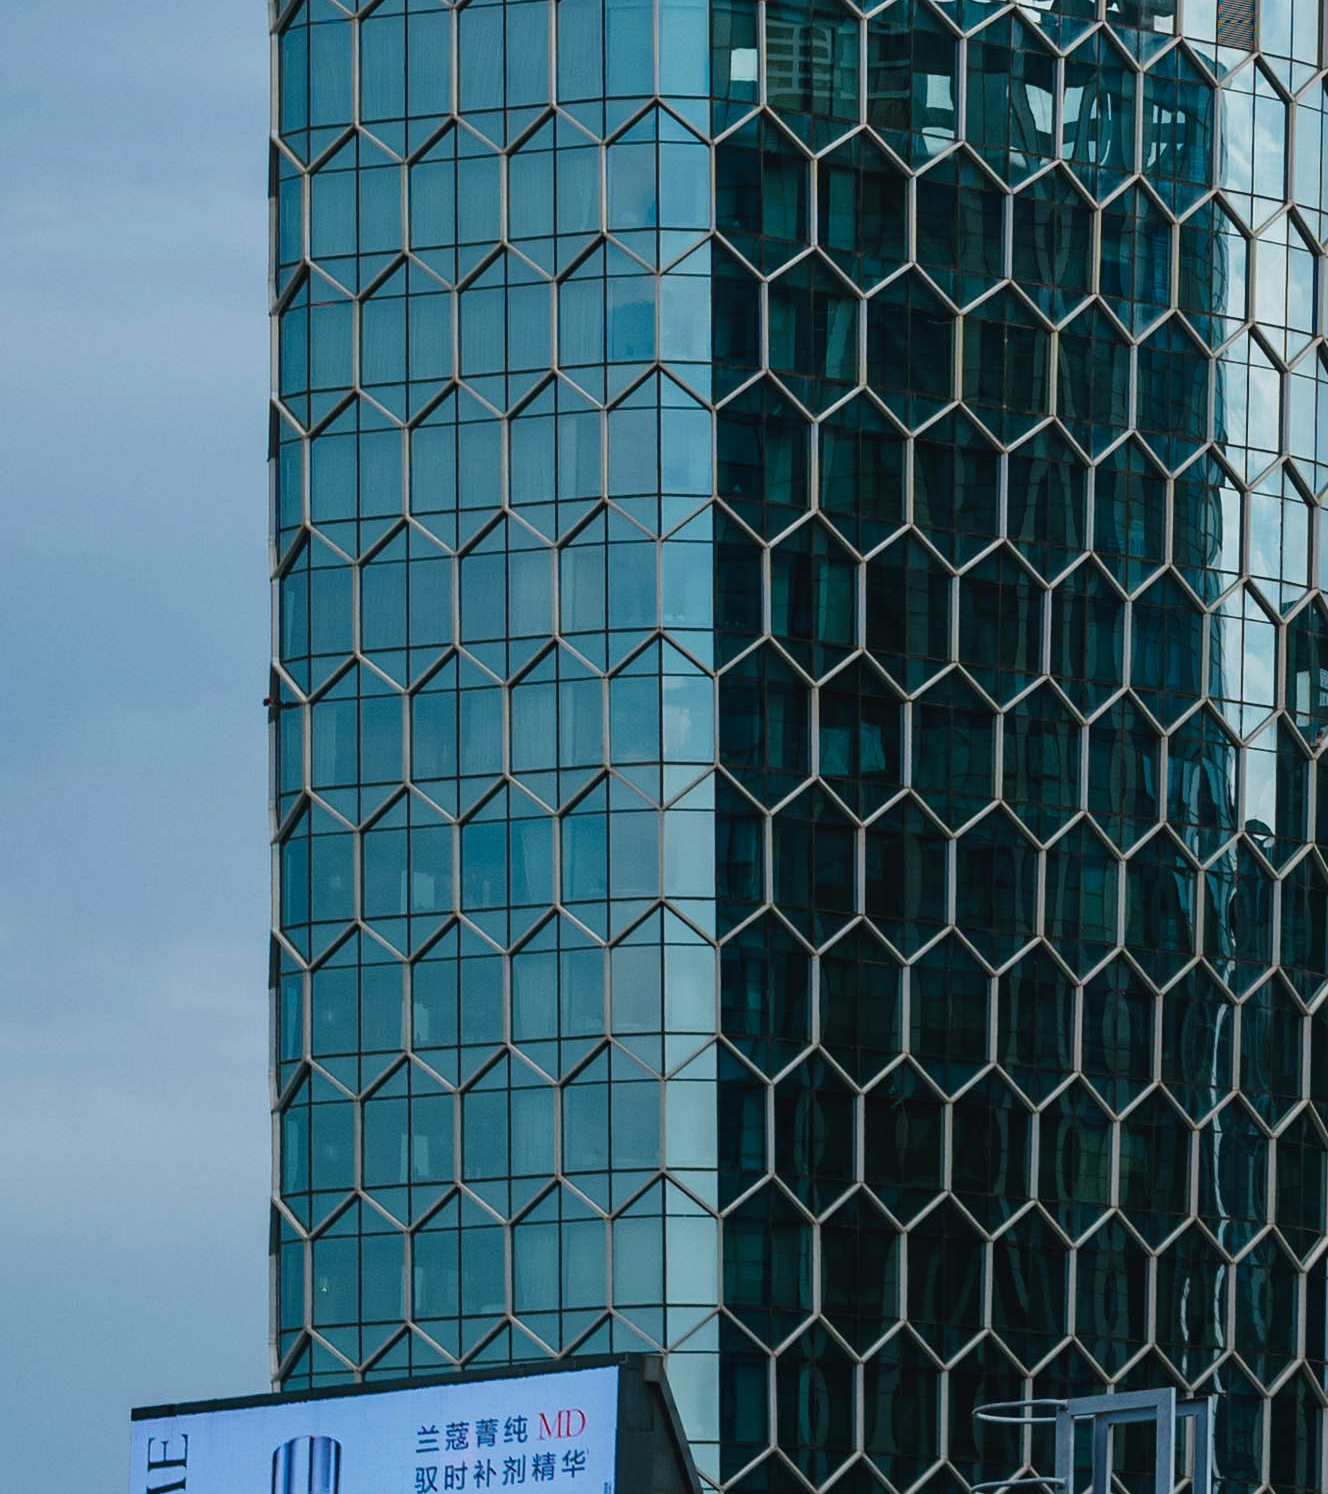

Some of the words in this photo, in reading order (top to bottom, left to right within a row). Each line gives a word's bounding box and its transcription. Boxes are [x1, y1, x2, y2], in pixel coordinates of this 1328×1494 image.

[415, 1414, 529, 1453] 兰蔻菁纯
[536, 1408, 587, 1441] MD
[414, 1449, 586, 1494] 驭时补剂精华
